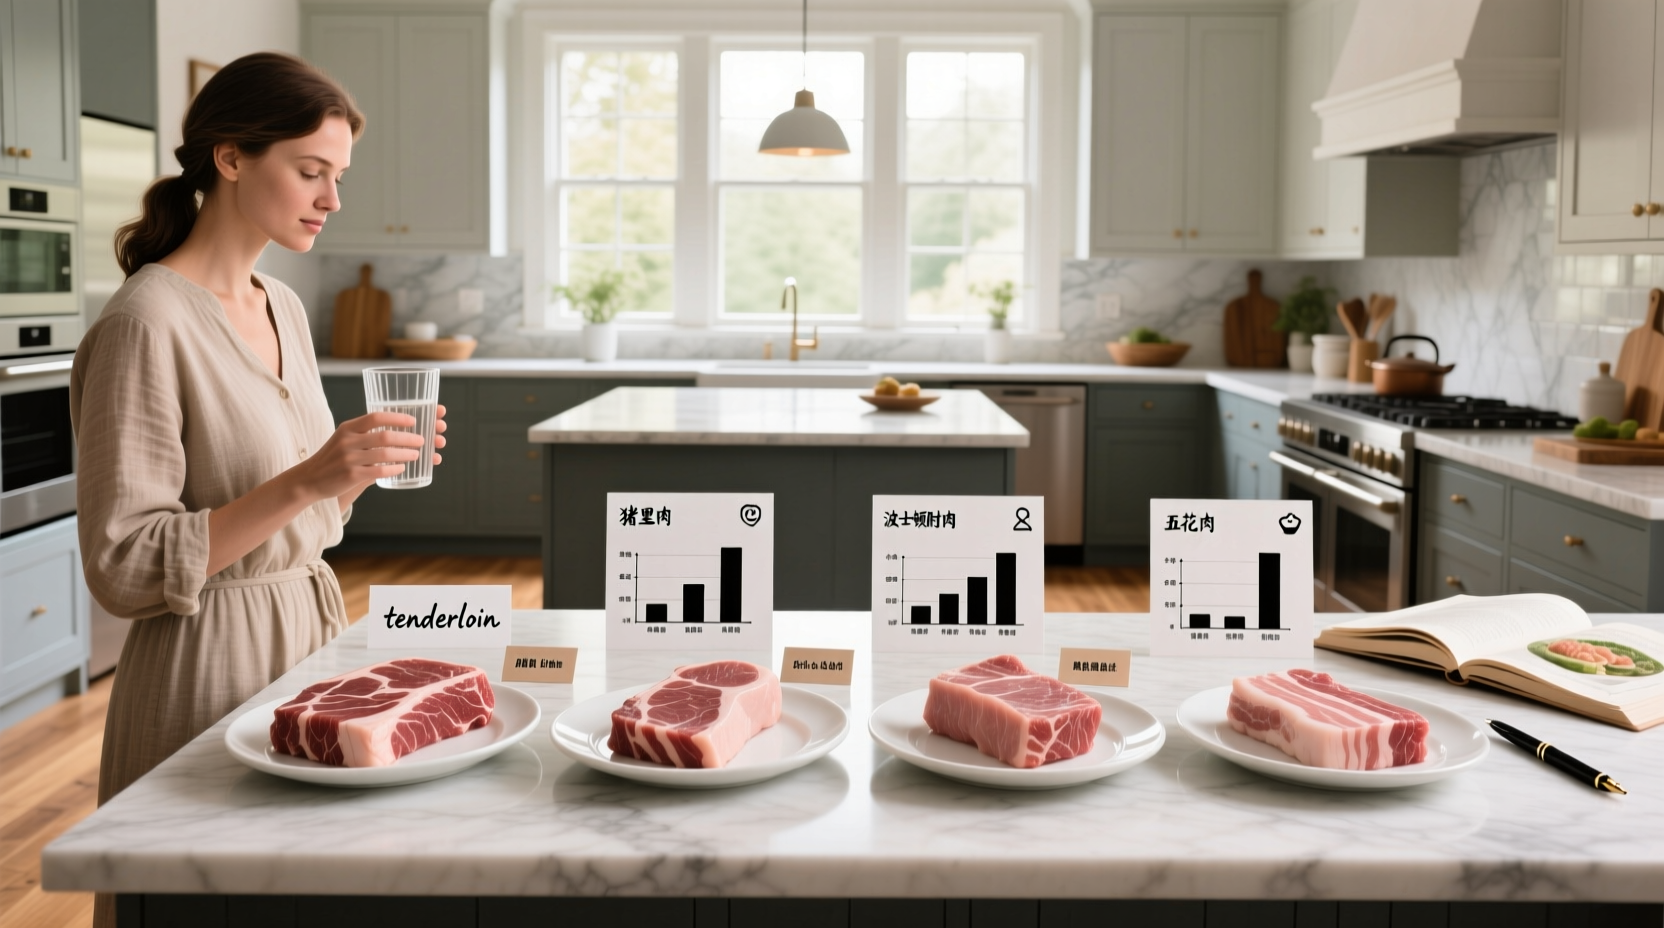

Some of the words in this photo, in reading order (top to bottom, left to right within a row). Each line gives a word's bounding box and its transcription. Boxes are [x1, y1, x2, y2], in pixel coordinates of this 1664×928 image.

[1164, 511, 1215, 533] 五花肉
[383, 601, 501, 629] tenderloin
